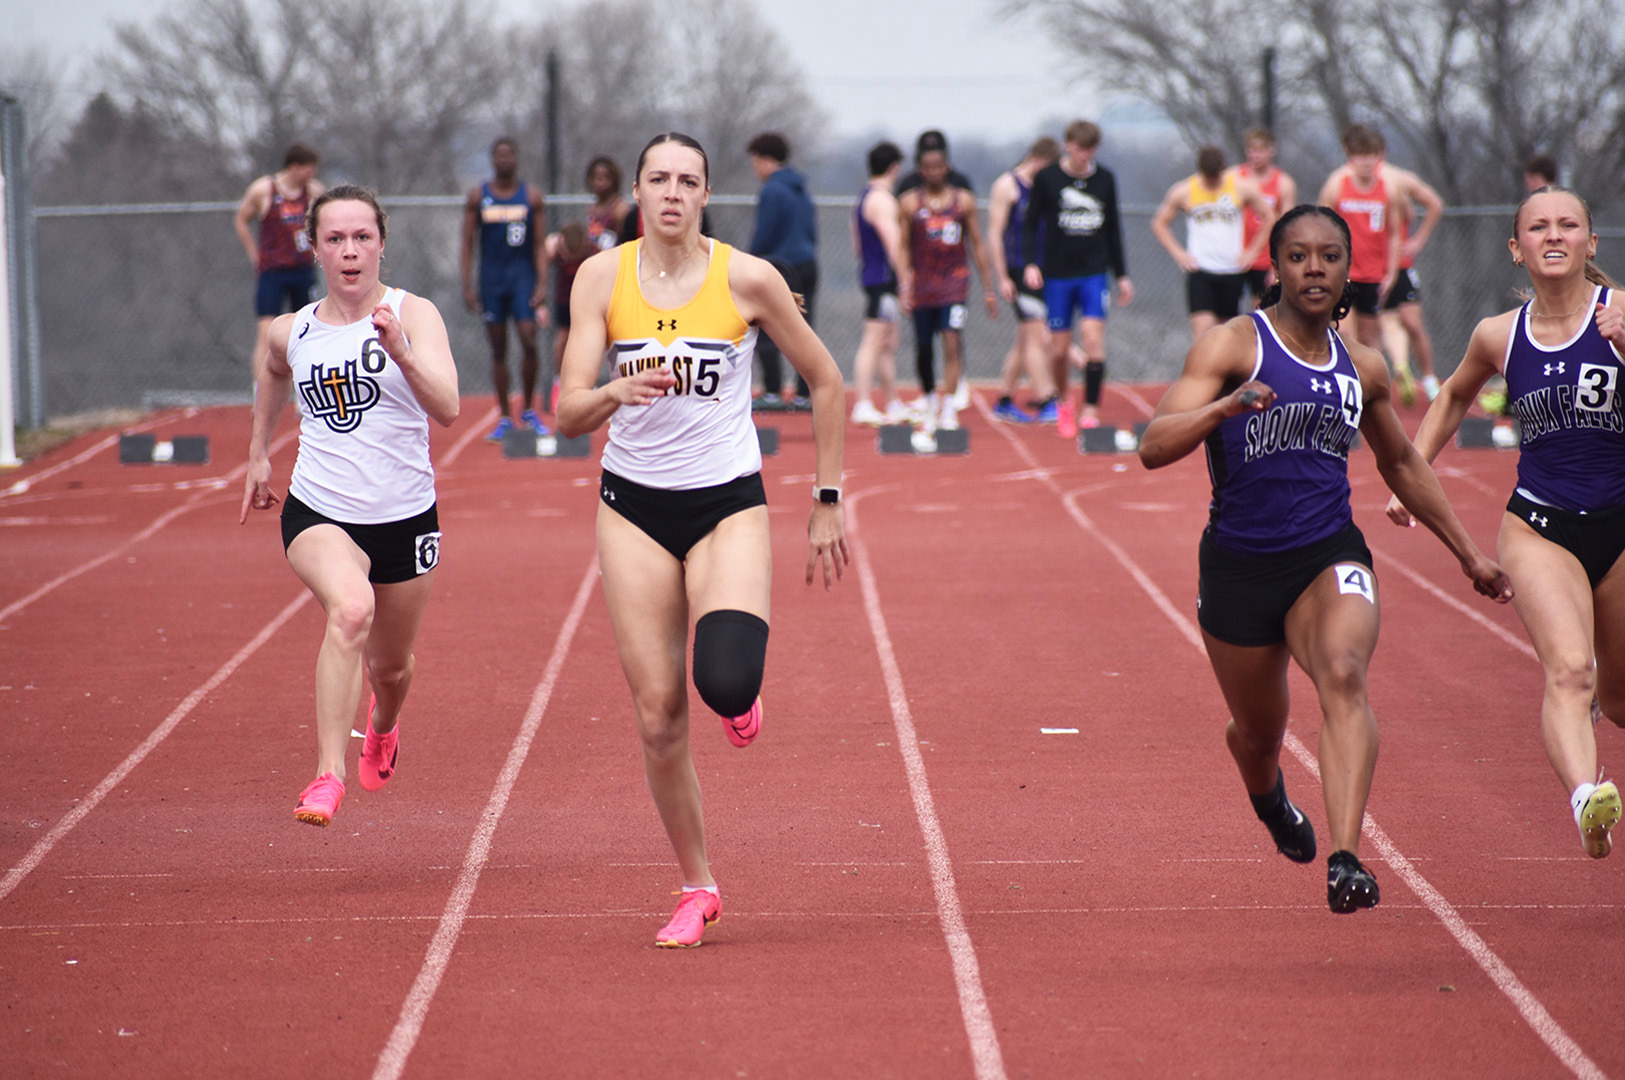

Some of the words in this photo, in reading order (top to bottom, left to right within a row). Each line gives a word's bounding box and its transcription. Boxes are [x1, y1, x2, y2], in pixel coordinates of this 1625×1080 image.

[361, 338, 386, 374] 6
[694, 358, 720, 397] 5
[1580, 368, 1610, 409] 3
[1343, 380, 1359, 423] 4
[1244, 402, 1316, 462] SIOUX
[419, 536, 437, 569] 6
[1344, 569, 1369, 594] 4
